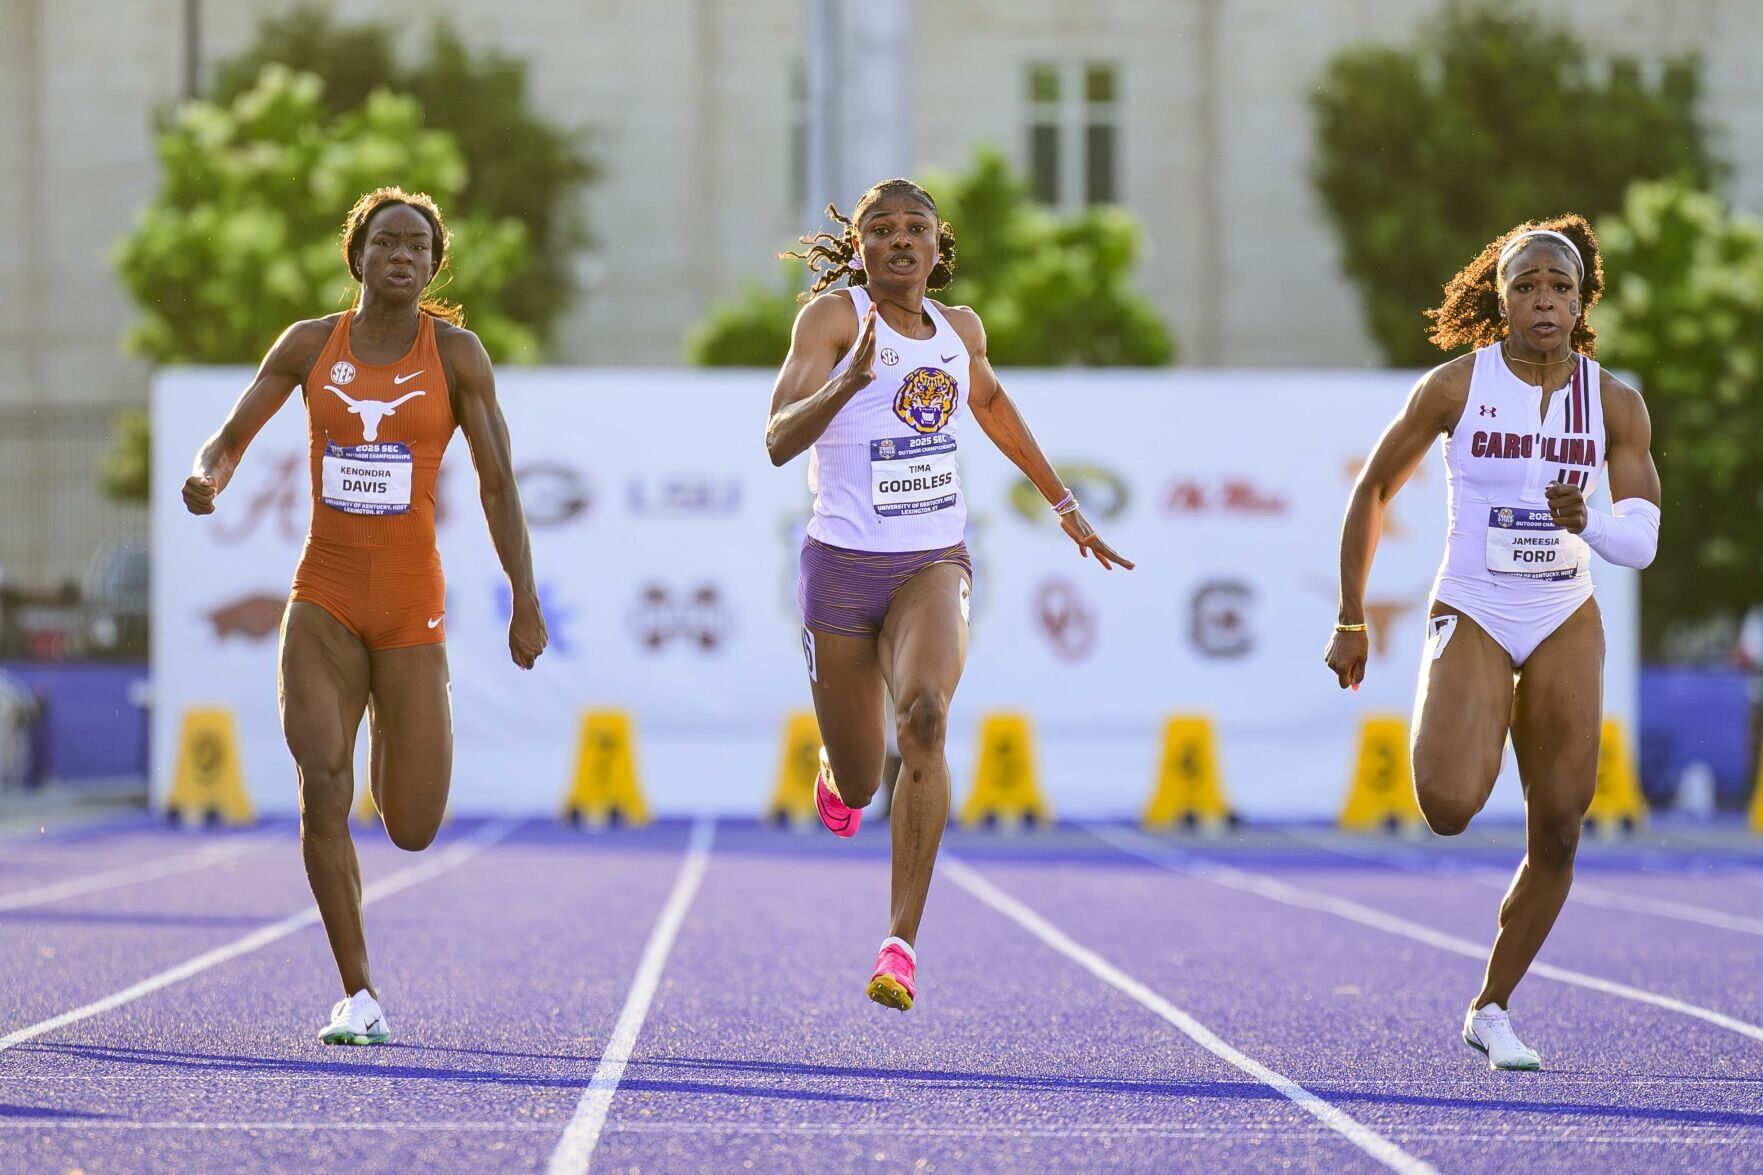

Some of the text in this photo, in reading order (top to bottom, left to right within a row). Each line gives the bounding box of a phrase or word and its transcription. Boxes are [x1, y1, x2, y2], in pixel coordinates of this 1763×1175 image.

[881, 348, 899, 366] SEC
[332, 362, 355, 384] SEC
[910, 434, 946, 448] 2025 SEC
[356, 443, 399, 453] 2025 SEC
[1471, 431, 1596, 467] CAROLINA
[340, 466, 391, 478] KENONDRA
[909, 464, 931, 474] TIMA
[342, 479, 387, 494] DAVIS
[879, 472, 952, 493] GODBLESS
[877, 503, 911, 511] UNIVERSITY
[1512, 538, 1560, 546] JAMEESIA
[1513, 550, 1556, 563] FORD
